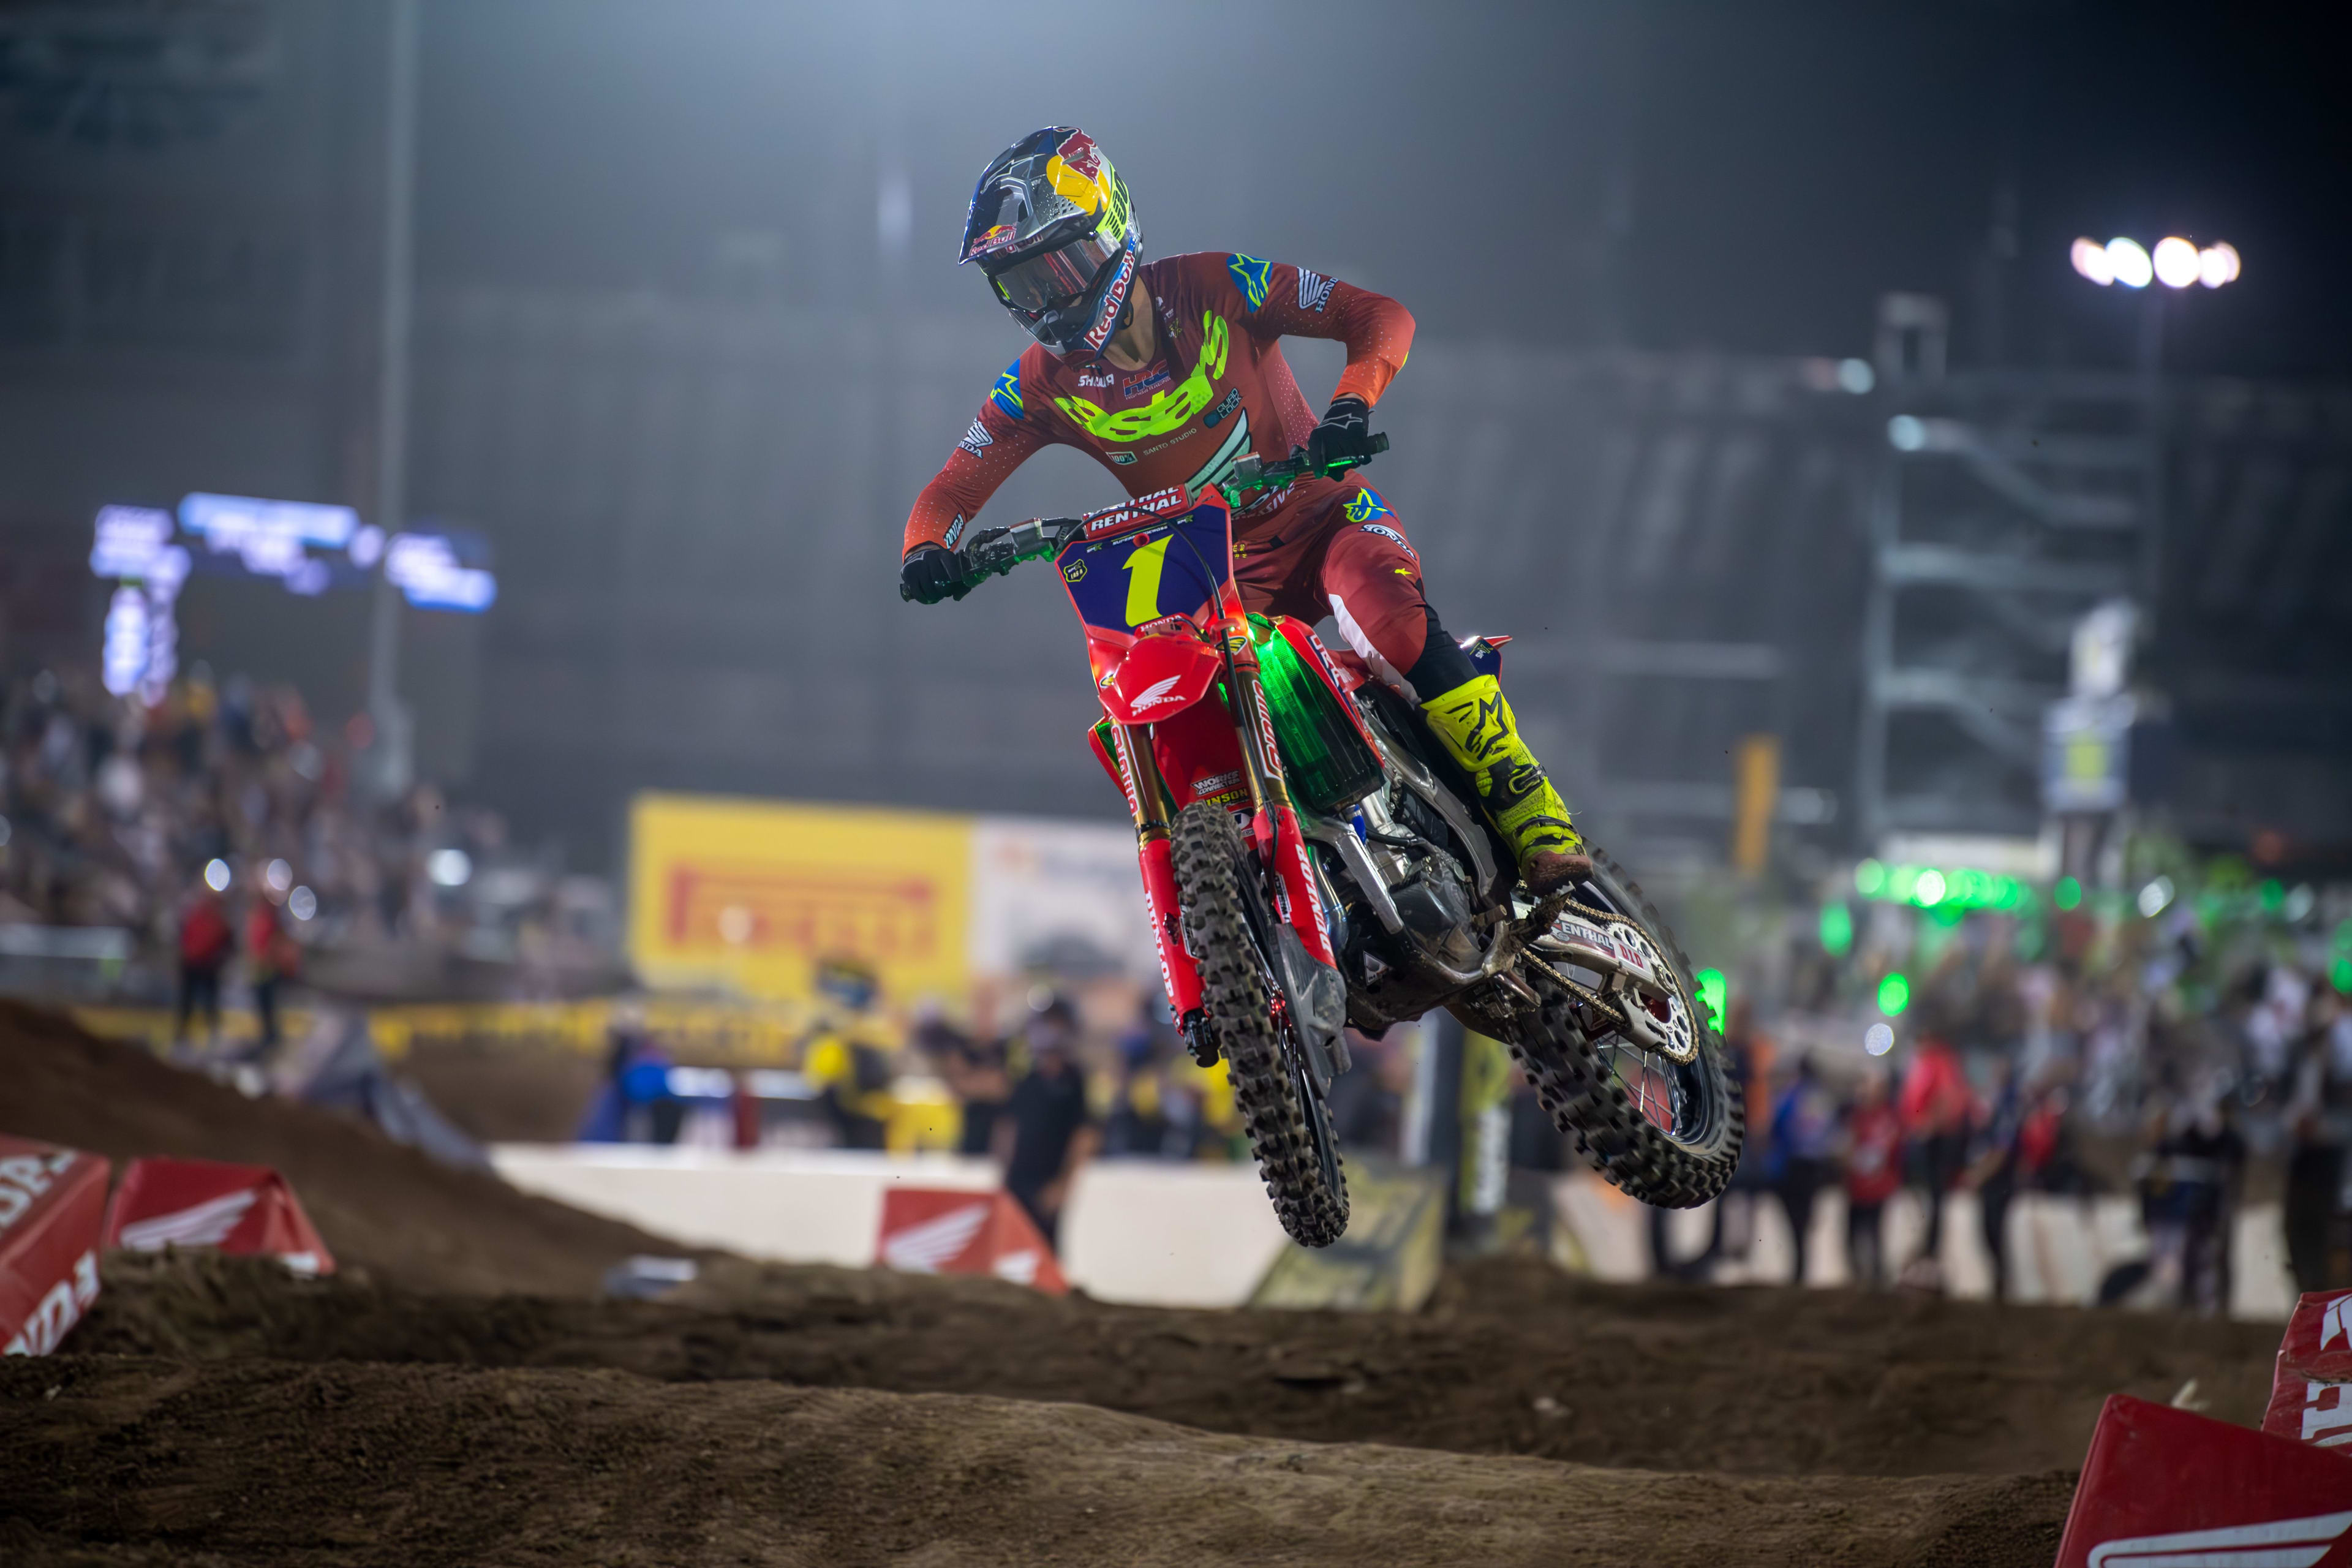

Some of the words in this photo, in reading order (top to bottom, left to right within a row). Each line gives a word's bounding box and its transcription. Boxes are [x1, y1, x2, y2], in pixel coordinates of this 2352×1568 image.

[968, 240, 990, 257] Red
[990, 230, 1016, 246] Bull
[1084, 296, 1118, 350] Red
[1111, 250, 1136, 300] Bull
[1315, 277, 1340, 313] HOND
[1216, 387, 1239, 413] QUAD
[1221, 396, 1243, 418] LOCK
[957, 440, 983, 459] NDA
[1143, 442, 1169, 456] SANTO
[1170, 428, 1197, 445] STUDIO
[1111, 453, 1133, 462] 100%
[1122, 534, 1174, 627] 1
[1132, 695, 1187, 717] HONDA
[1193, 771, 1239, 790] WORKS
[1205, 788, 1249, 807] INSON
[1294, 843, 1334, 957] DUNLOP
[1145, 889, 1174, 998] DUNLOP
[1619, 943, 1644, 969] DID
